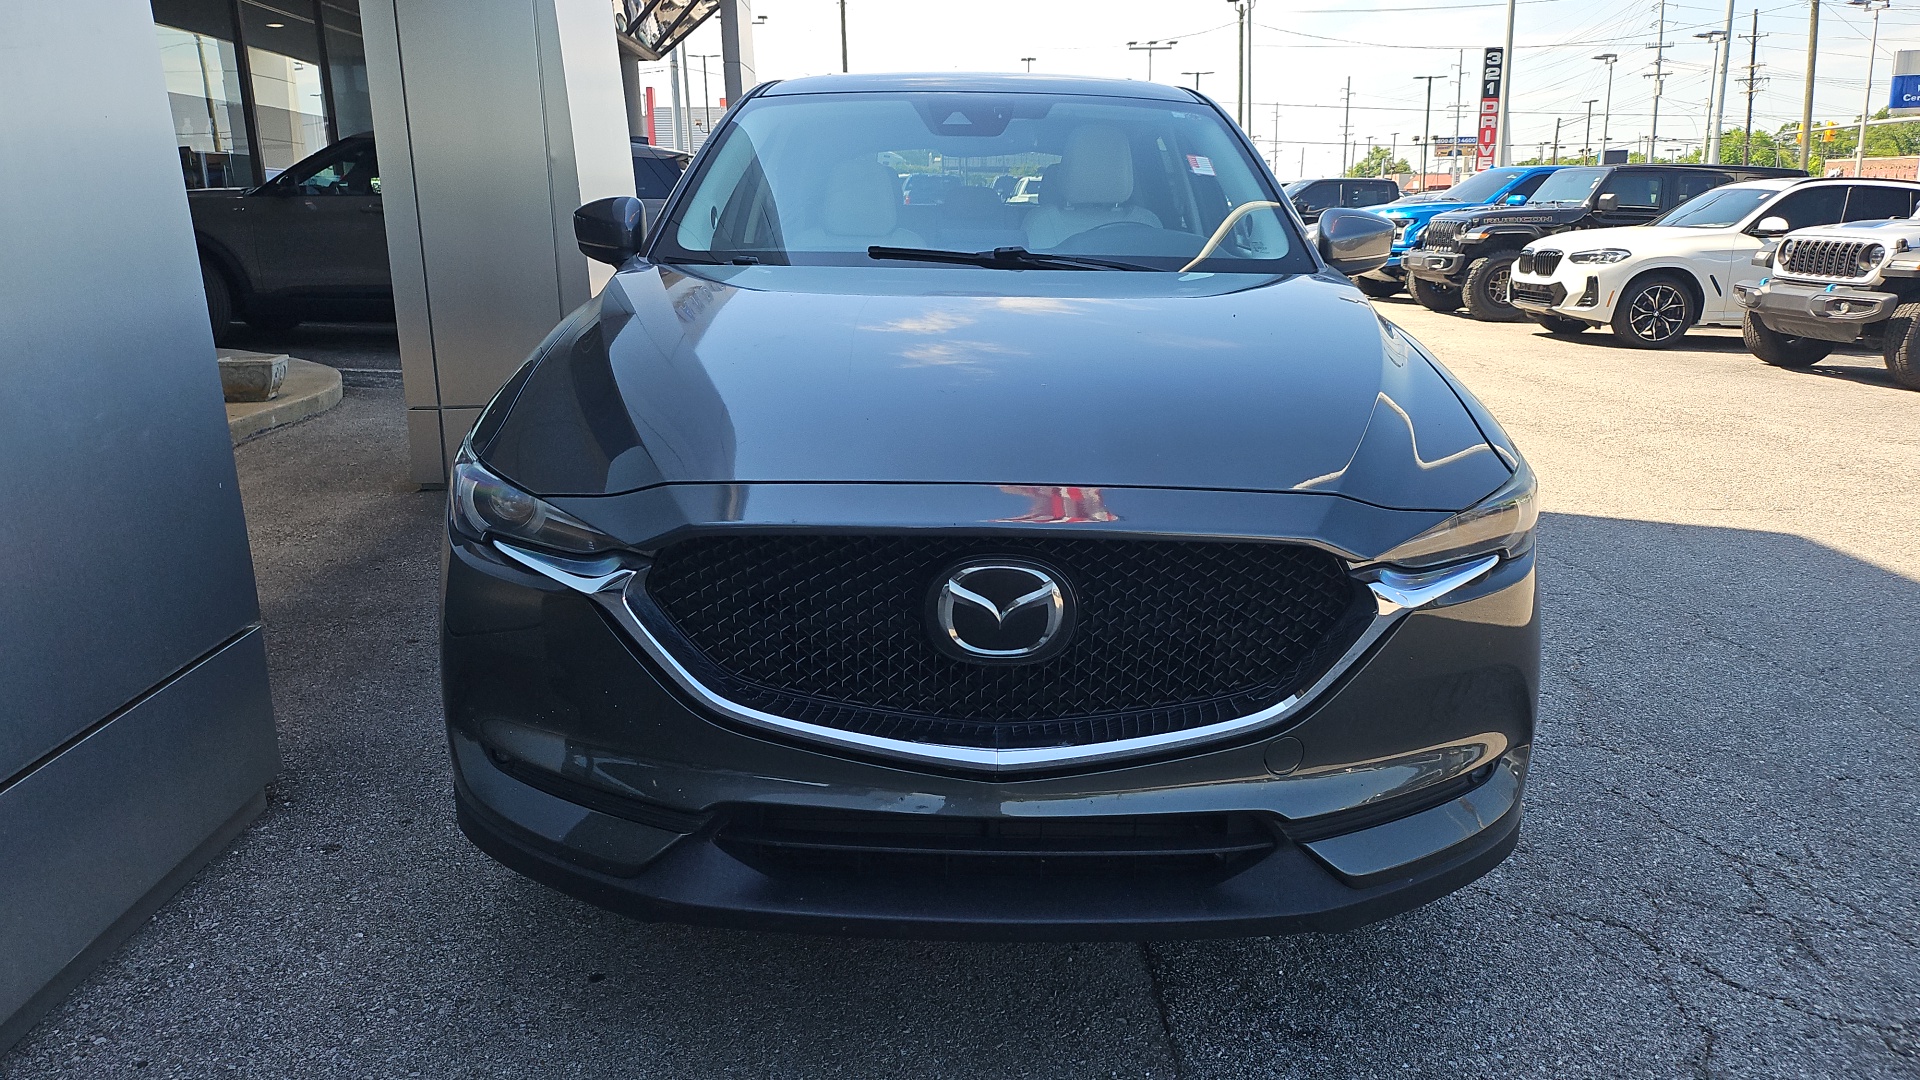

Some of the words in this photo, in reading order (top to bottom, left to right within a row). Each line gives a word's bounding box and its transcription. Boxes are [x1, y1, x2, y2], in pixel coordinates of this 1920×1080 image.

[1484, 52, 1502, 94] 321
[1477, 101, 1498, 170] DRIVE
[1483, 216, 1553, 224] RUBICON
